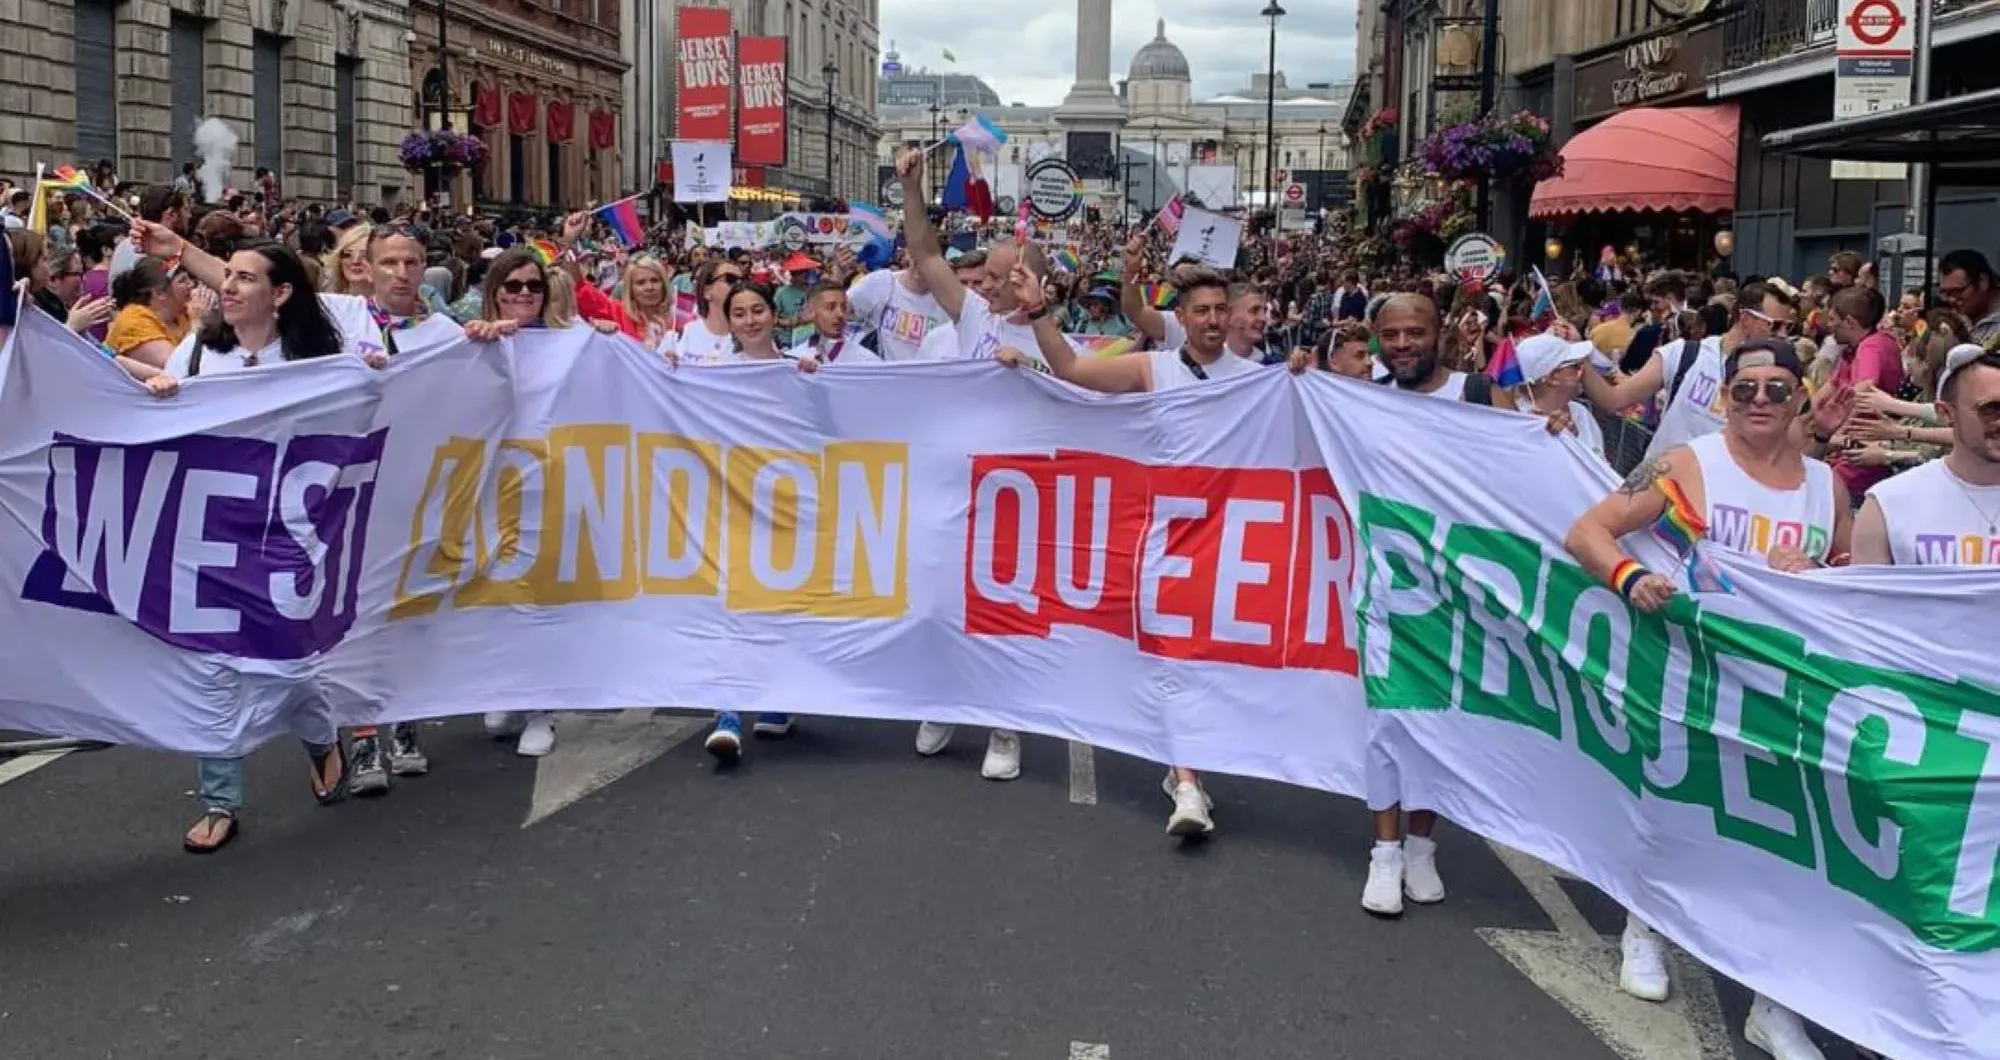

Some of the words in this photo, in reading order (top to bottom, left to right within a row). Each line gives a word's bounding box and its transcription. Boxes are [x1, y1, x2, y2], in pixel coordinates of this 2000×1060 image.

[680, 37, 731, 60] JERSEY
[683, 60, 730, 88] BOYS
[740, 62, 785, 84] JERSEY
[743, 84, 784, 108] BOYS
[52, 444, 379, 634] WEST
[403, 444, 905, 598] LONDON
[972, 468, 1358, 650] QUEER
[1365, 521, 2000, 918] PROJECT
